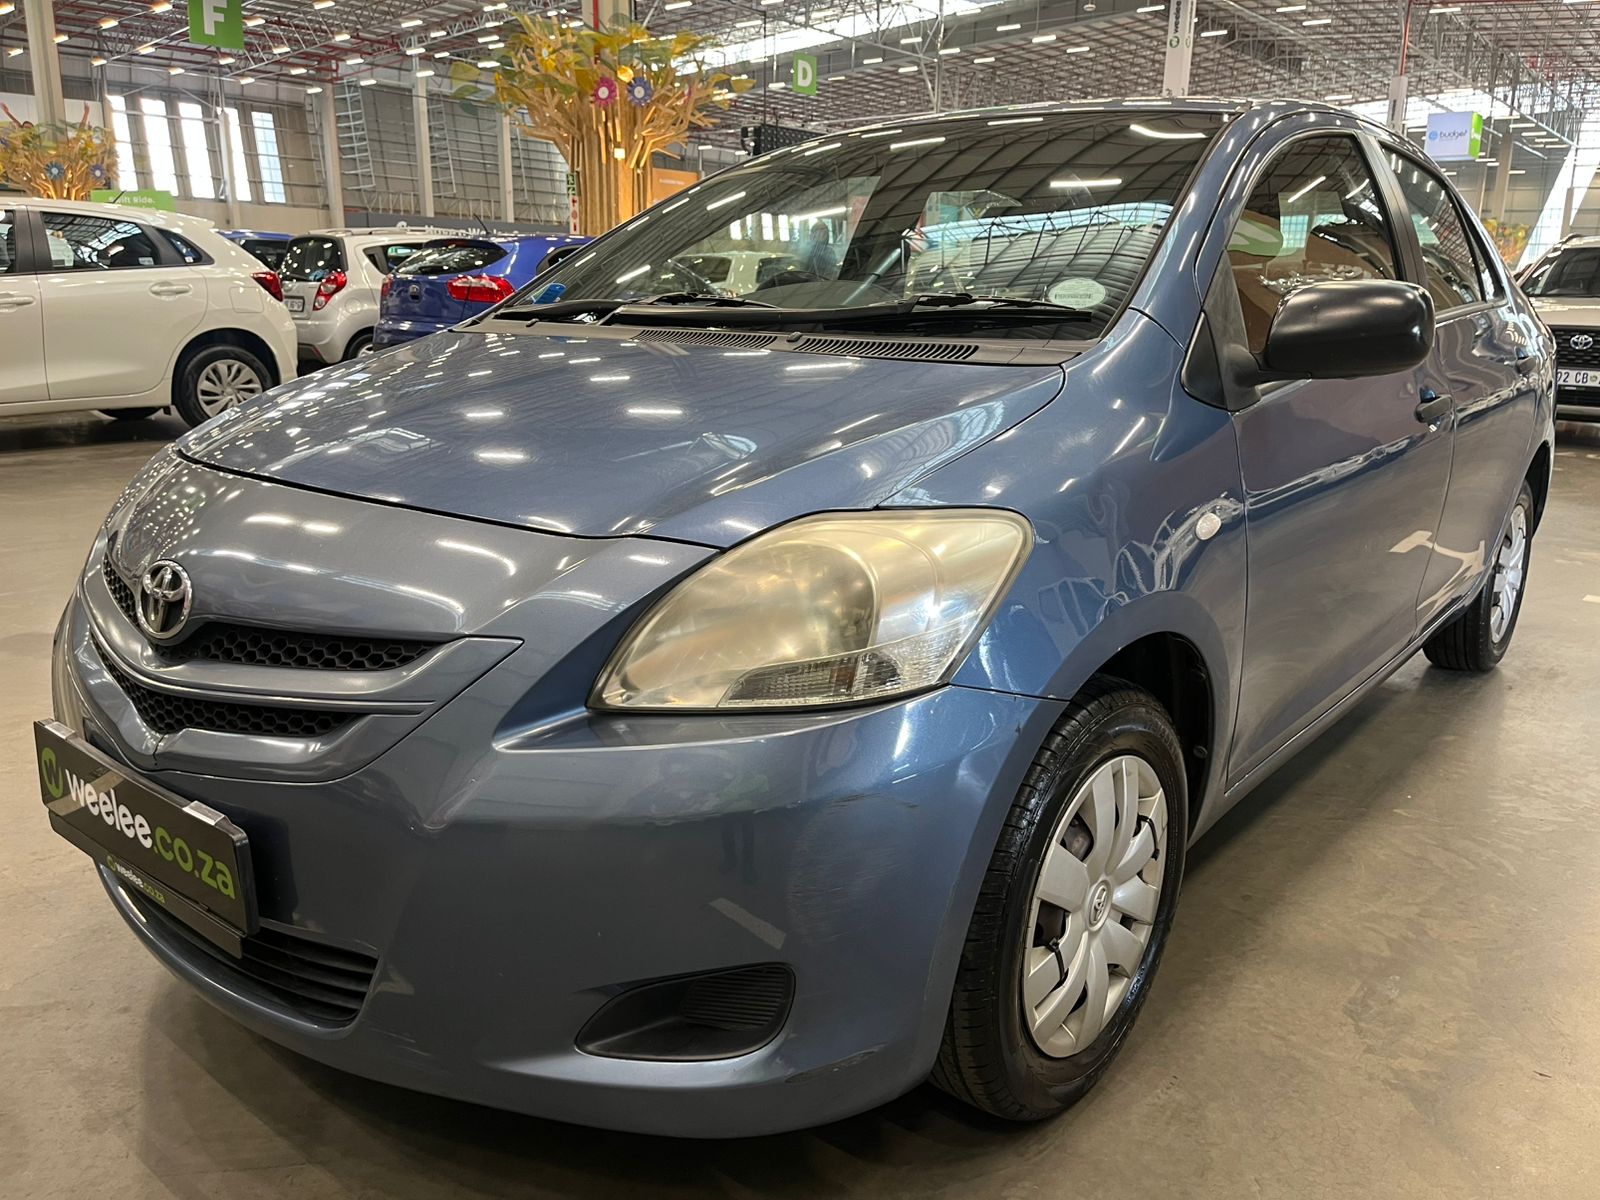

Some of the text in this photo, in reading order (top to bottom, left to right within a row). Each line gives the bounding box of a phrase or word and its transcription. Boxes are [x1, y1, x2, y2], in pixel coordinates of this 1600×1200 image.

[203, 0, 227, 36] F
[797, 59, 813, 87] D
[1575, 371, 1589, 384] CB
[65, 768, 236, 901] weelee.co.za
